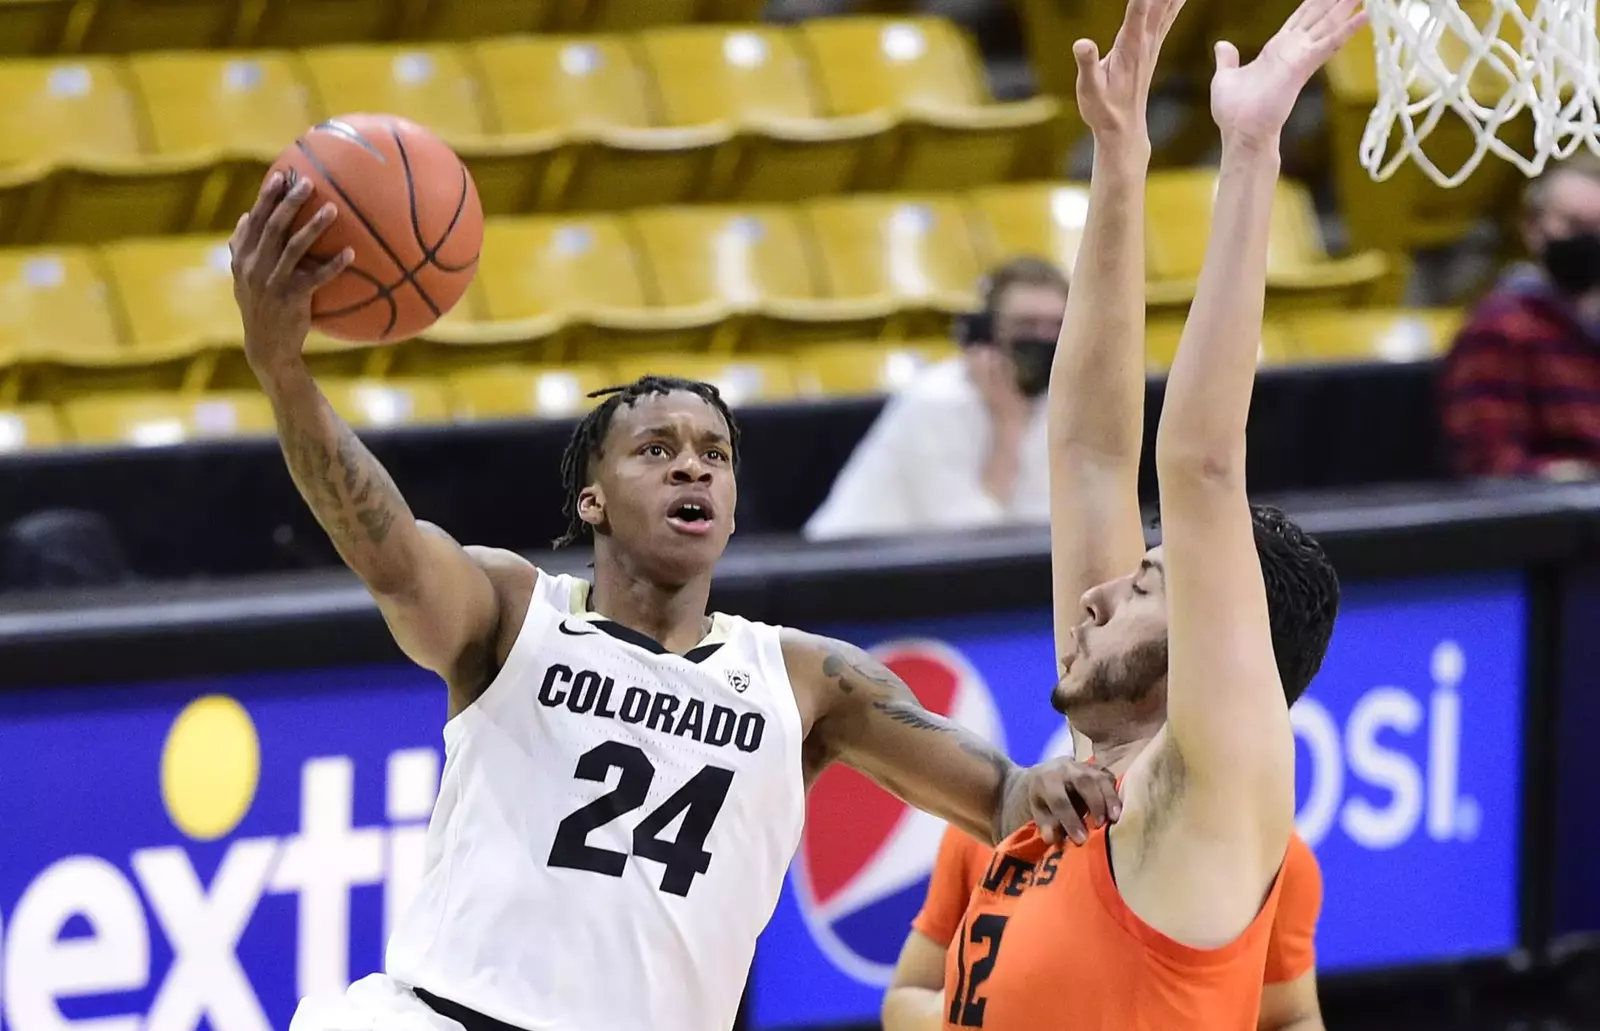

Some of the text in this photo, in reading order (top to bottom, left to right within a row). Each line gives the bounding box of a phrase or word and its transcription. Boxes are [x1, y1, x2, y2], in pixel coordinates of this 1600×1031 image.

[538, 664, 765, 752] COLORADO
[547, 740, 735, 897] 24
[0, 747, 440, 1031] exti
[949, 913, 1009, 1028] 12
